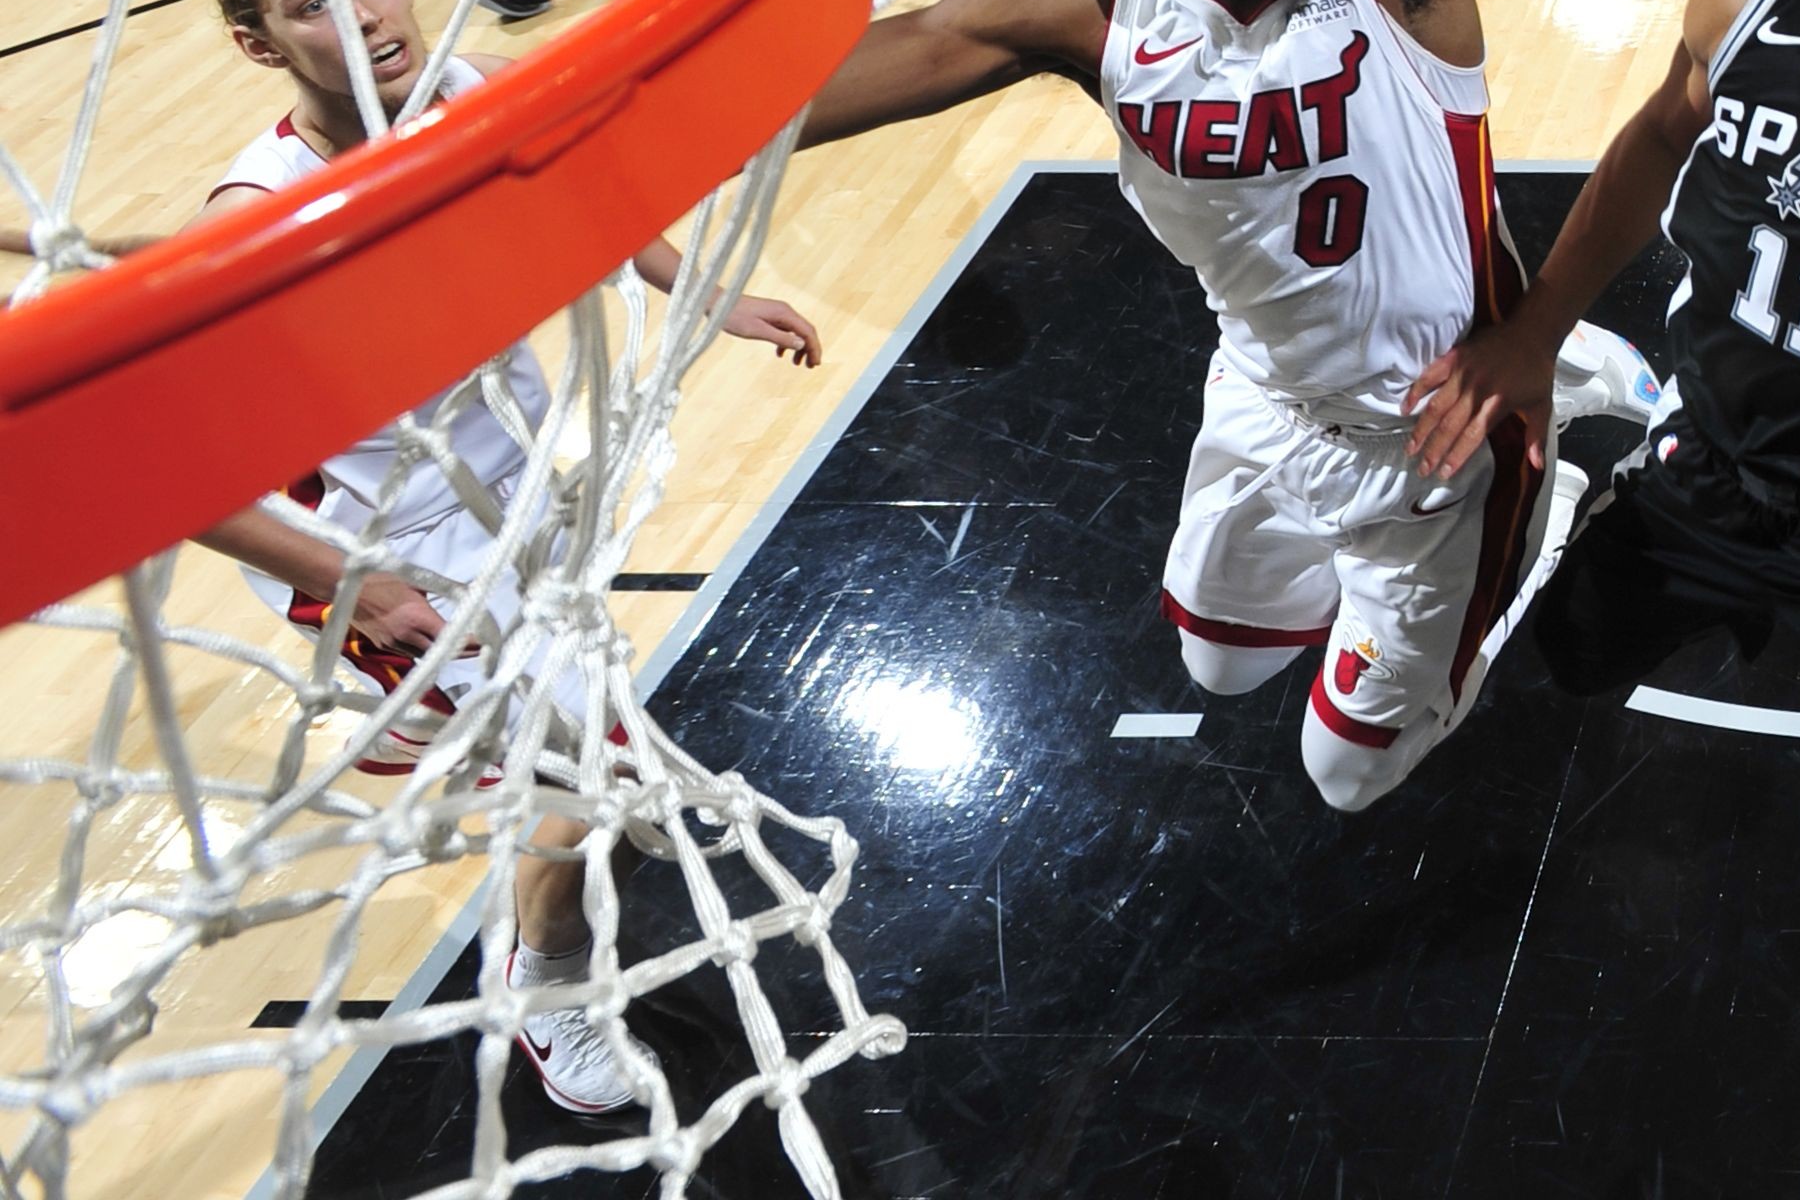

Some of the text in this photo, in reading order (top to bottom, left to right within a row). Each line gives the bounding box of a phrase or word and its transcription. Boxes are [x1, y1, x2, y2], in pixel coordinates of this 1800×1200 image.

[1290, 8, 1349, 32] OFTWARE
[1118, 29, 1370, 179] HEAT
[1294, 173, 1370, 268] 0
